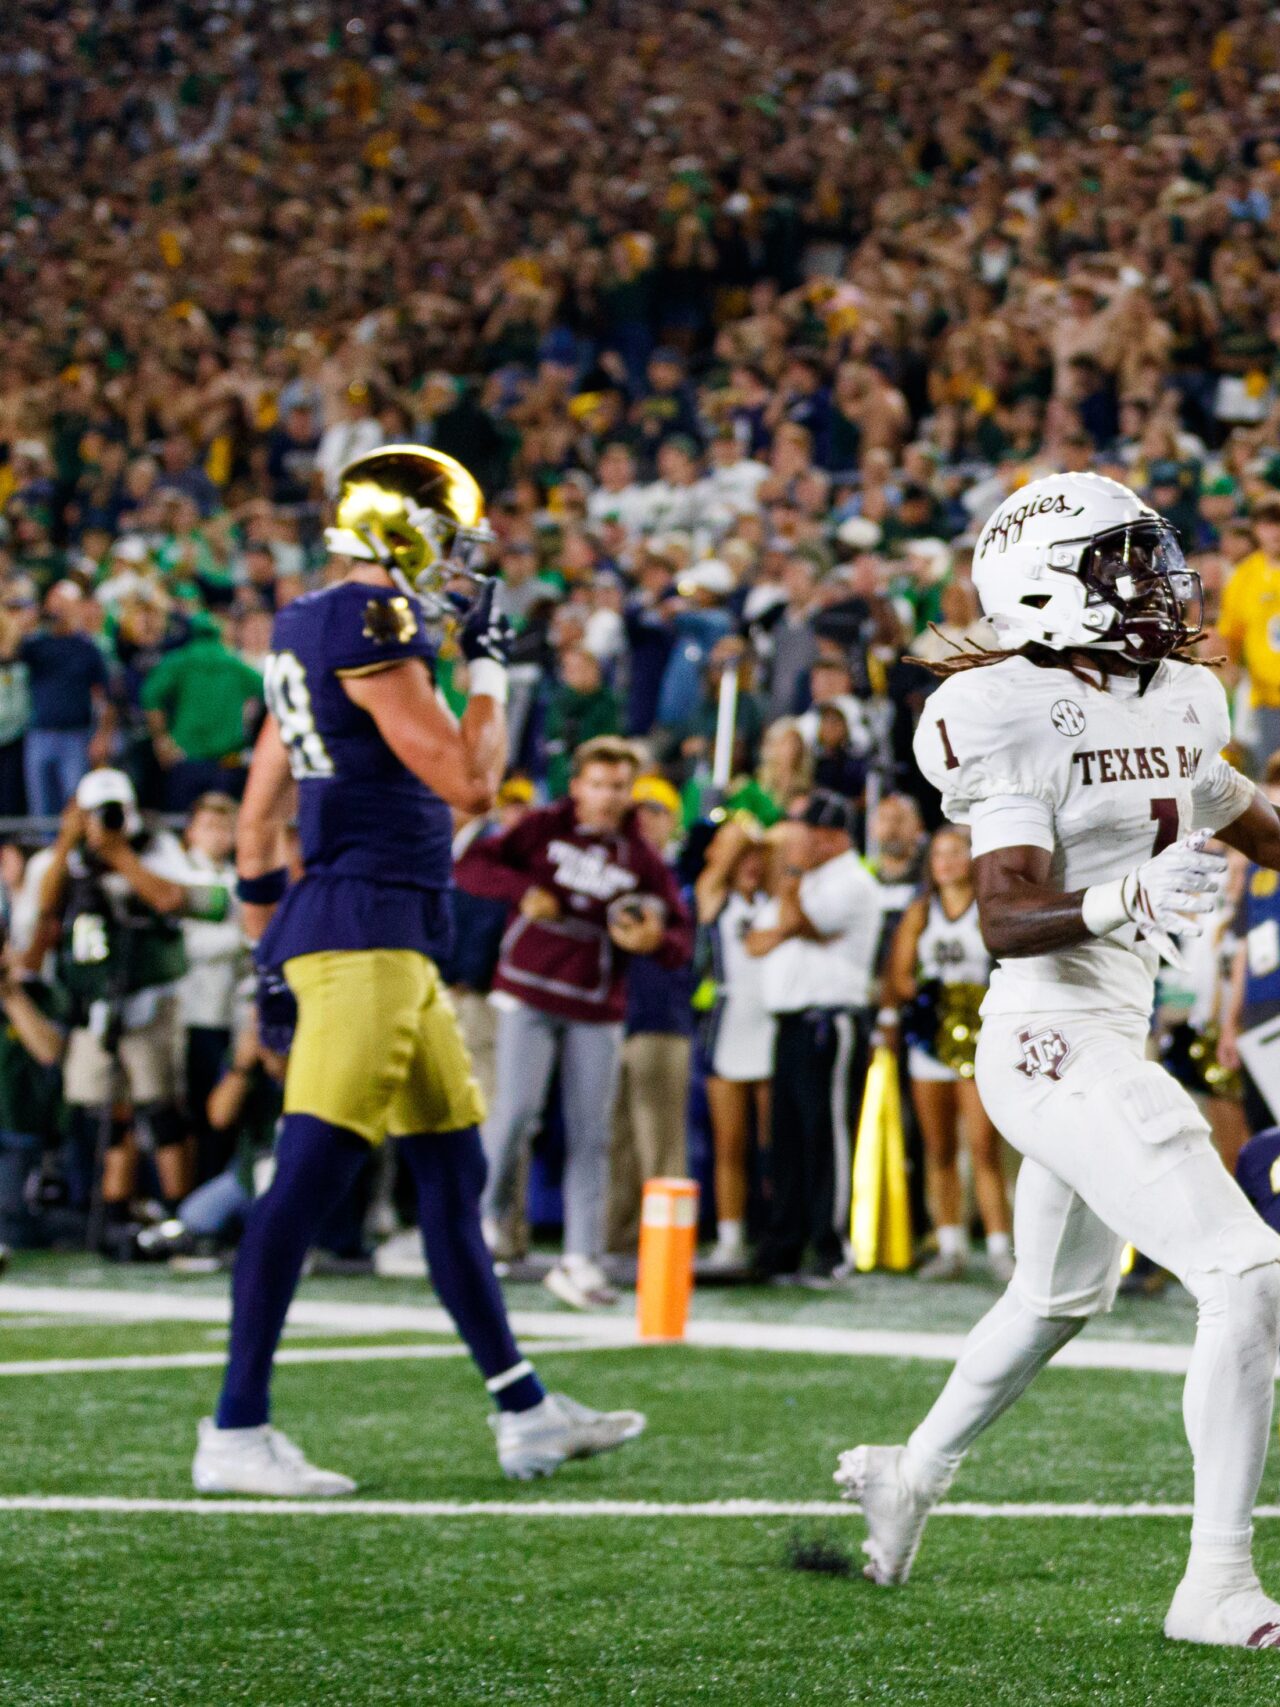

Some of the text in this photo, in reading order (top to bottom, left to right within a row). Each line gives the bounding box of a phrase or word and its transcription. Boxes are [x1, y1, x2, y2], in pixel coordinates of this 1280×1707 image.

[980, 494, 1085, 559] Aggies
[935, 717, 960, 771] 1
[1072, 746, 1170, 785] TEXAS
